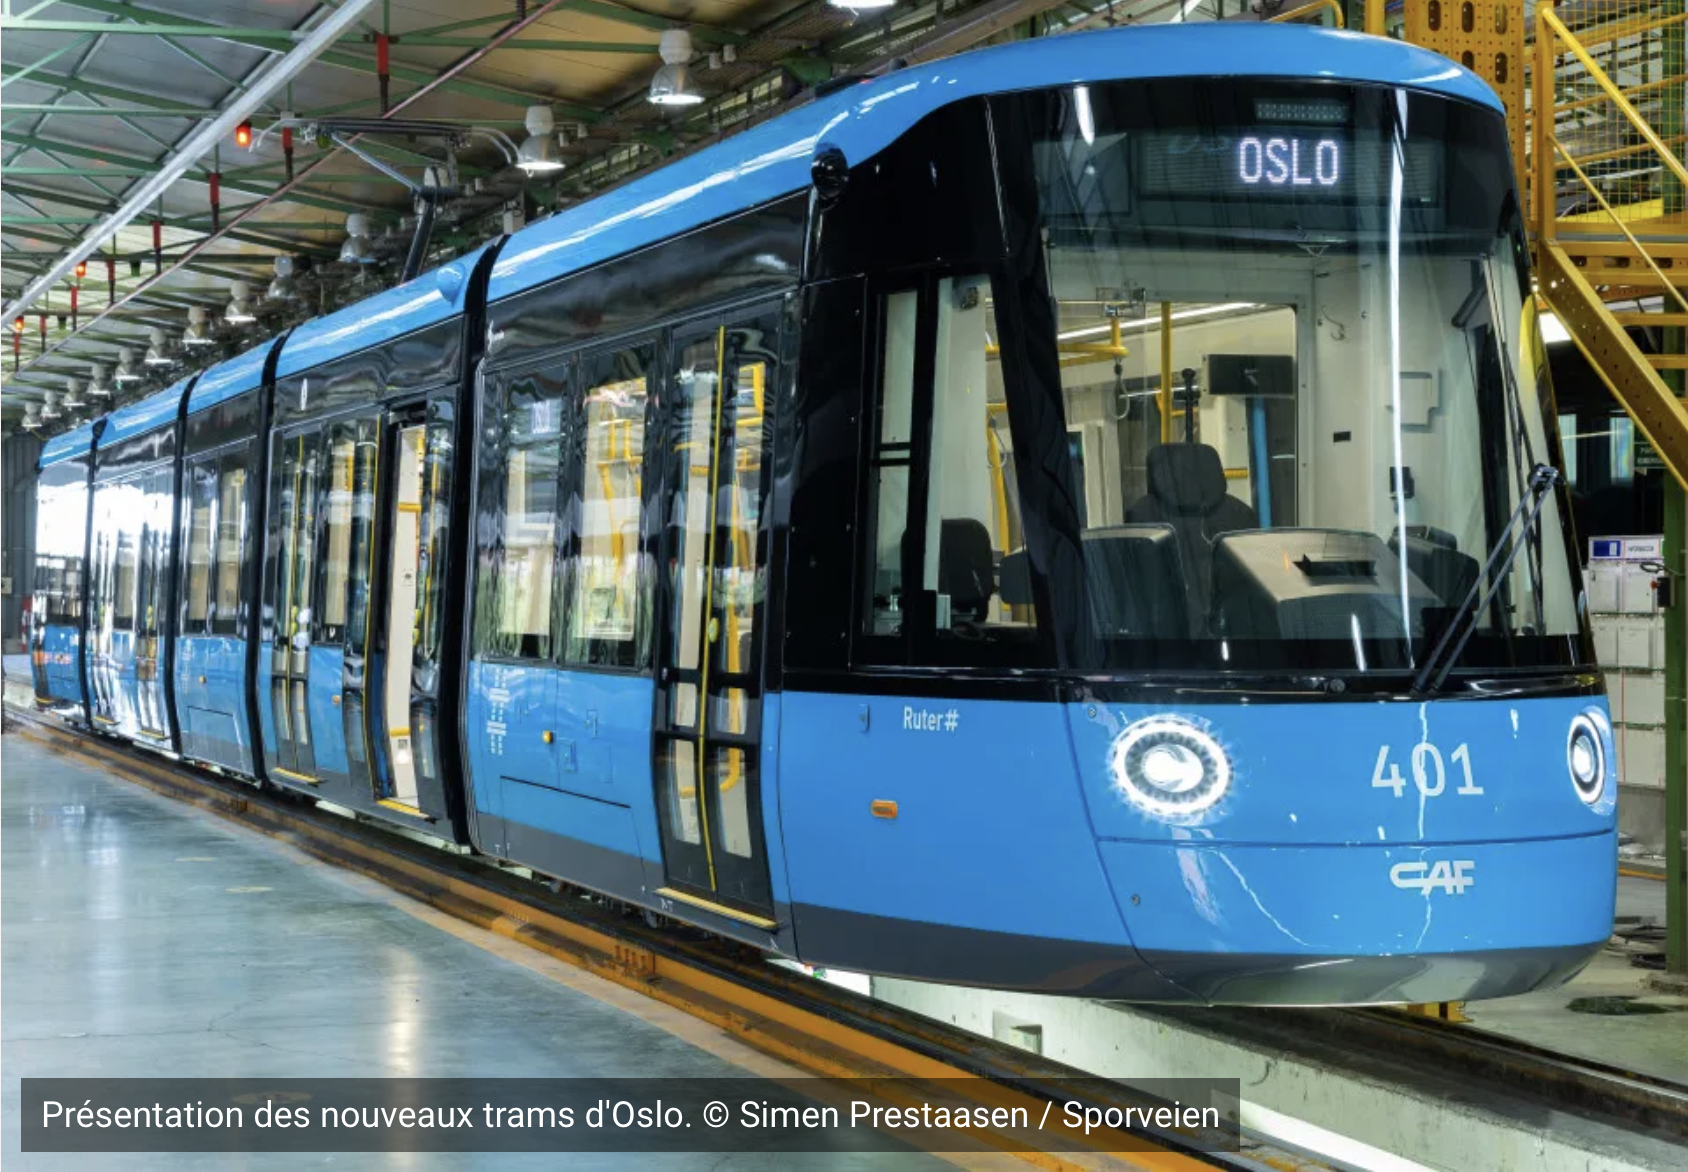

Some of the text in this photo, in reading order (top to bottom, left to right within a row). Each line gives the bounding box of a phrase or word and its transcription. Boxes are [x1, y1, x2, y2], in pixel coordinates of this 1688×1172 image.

[1238, 137, 1339, 186] OSLO
[903, 706, 960, 731] Ruter#
[1371, 742, 1485, 798] 401
[1389, 860, 1475, 896] CAF
